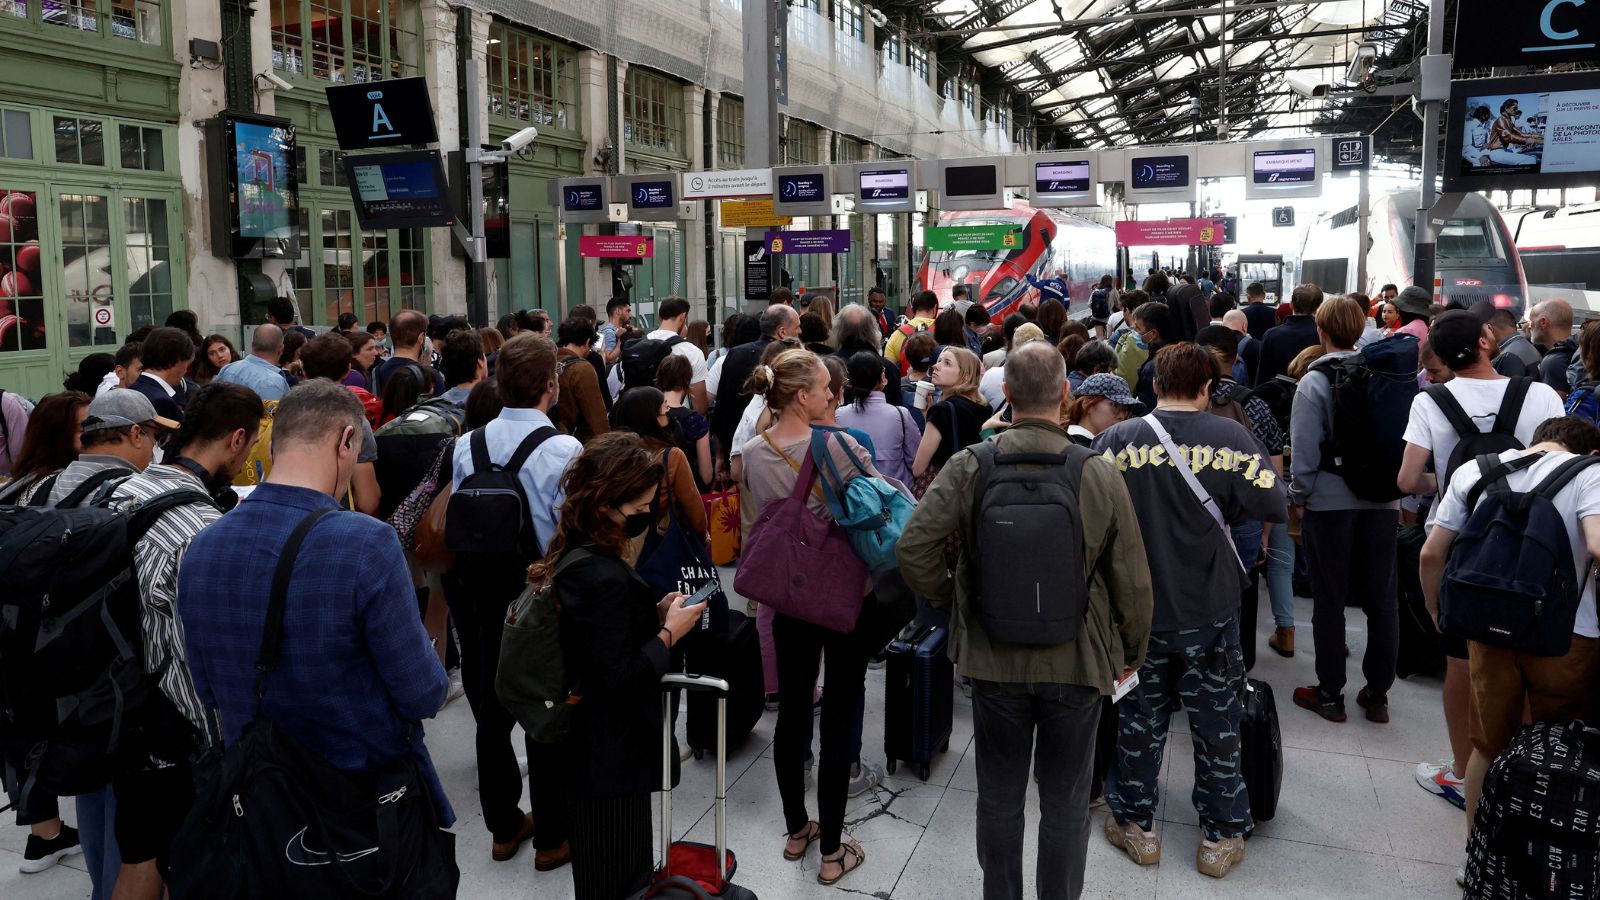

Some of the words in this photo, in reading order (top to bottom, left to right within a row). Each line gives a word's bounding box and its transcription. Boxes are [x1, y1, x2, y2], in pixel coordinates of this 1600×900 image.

[1539, 0, 1587, 41] C
[372, 103, 394, 133] A
[740, 175, 758, 183] jusqu'à
[1534, 771, 1551, 796] LAX
[1572, 808, 1590, 833] ZRH
